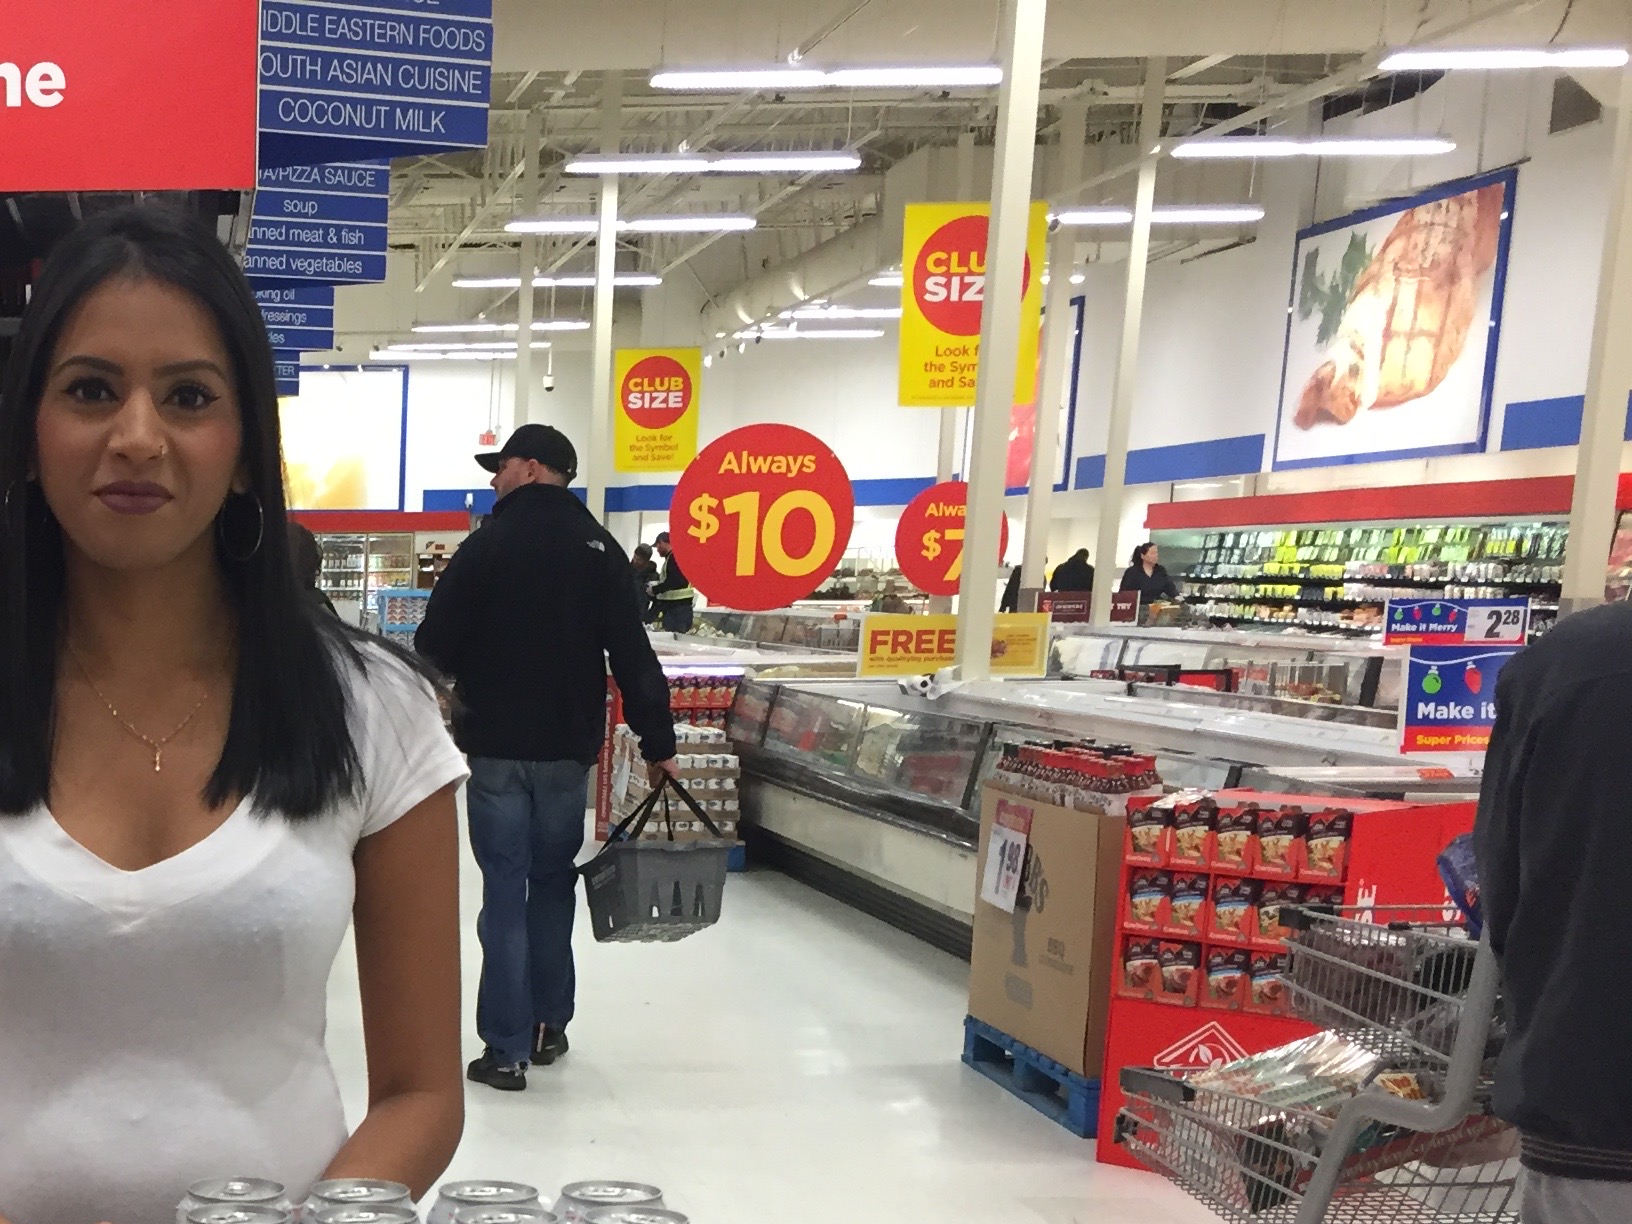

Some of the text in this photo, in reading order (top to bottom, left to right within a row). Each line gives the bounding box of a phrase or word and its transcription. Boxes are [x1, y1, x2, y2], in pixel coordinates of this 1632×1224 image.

[262, 10, 485, 51] IDDLE EASTERN FOODS
[260, 53, 482, 94] OUTH ASIAN CUISINE
[279, 98, 446, 133] COCONUT MILK
[325, 169, 376, 187] SAUCE
[284, 200, 318, 216] soup
[289, 227, 364, 245] meat & fish
[243, 255, 363, 275] anned vegetables
[926, 251, 987, 273] CLU
[923, 276, 985, 302] SIZ
[935, 345, 970, 357] Look
[924, 361, 945, 372] the
[629, 377, 684, 391] CLUB
[929, 376, 955, 388] and
[628, 392, 683, 409] SIZE
[718, 450, 817, 476] Always
[925, 502, 967, 517] Alwa
[687, 489, 836, 578] $10
[869, 630, 956, 654] FREE
[1417, 702, 1497, 719] Make it
[1416, 735, 1451, 746] Super
